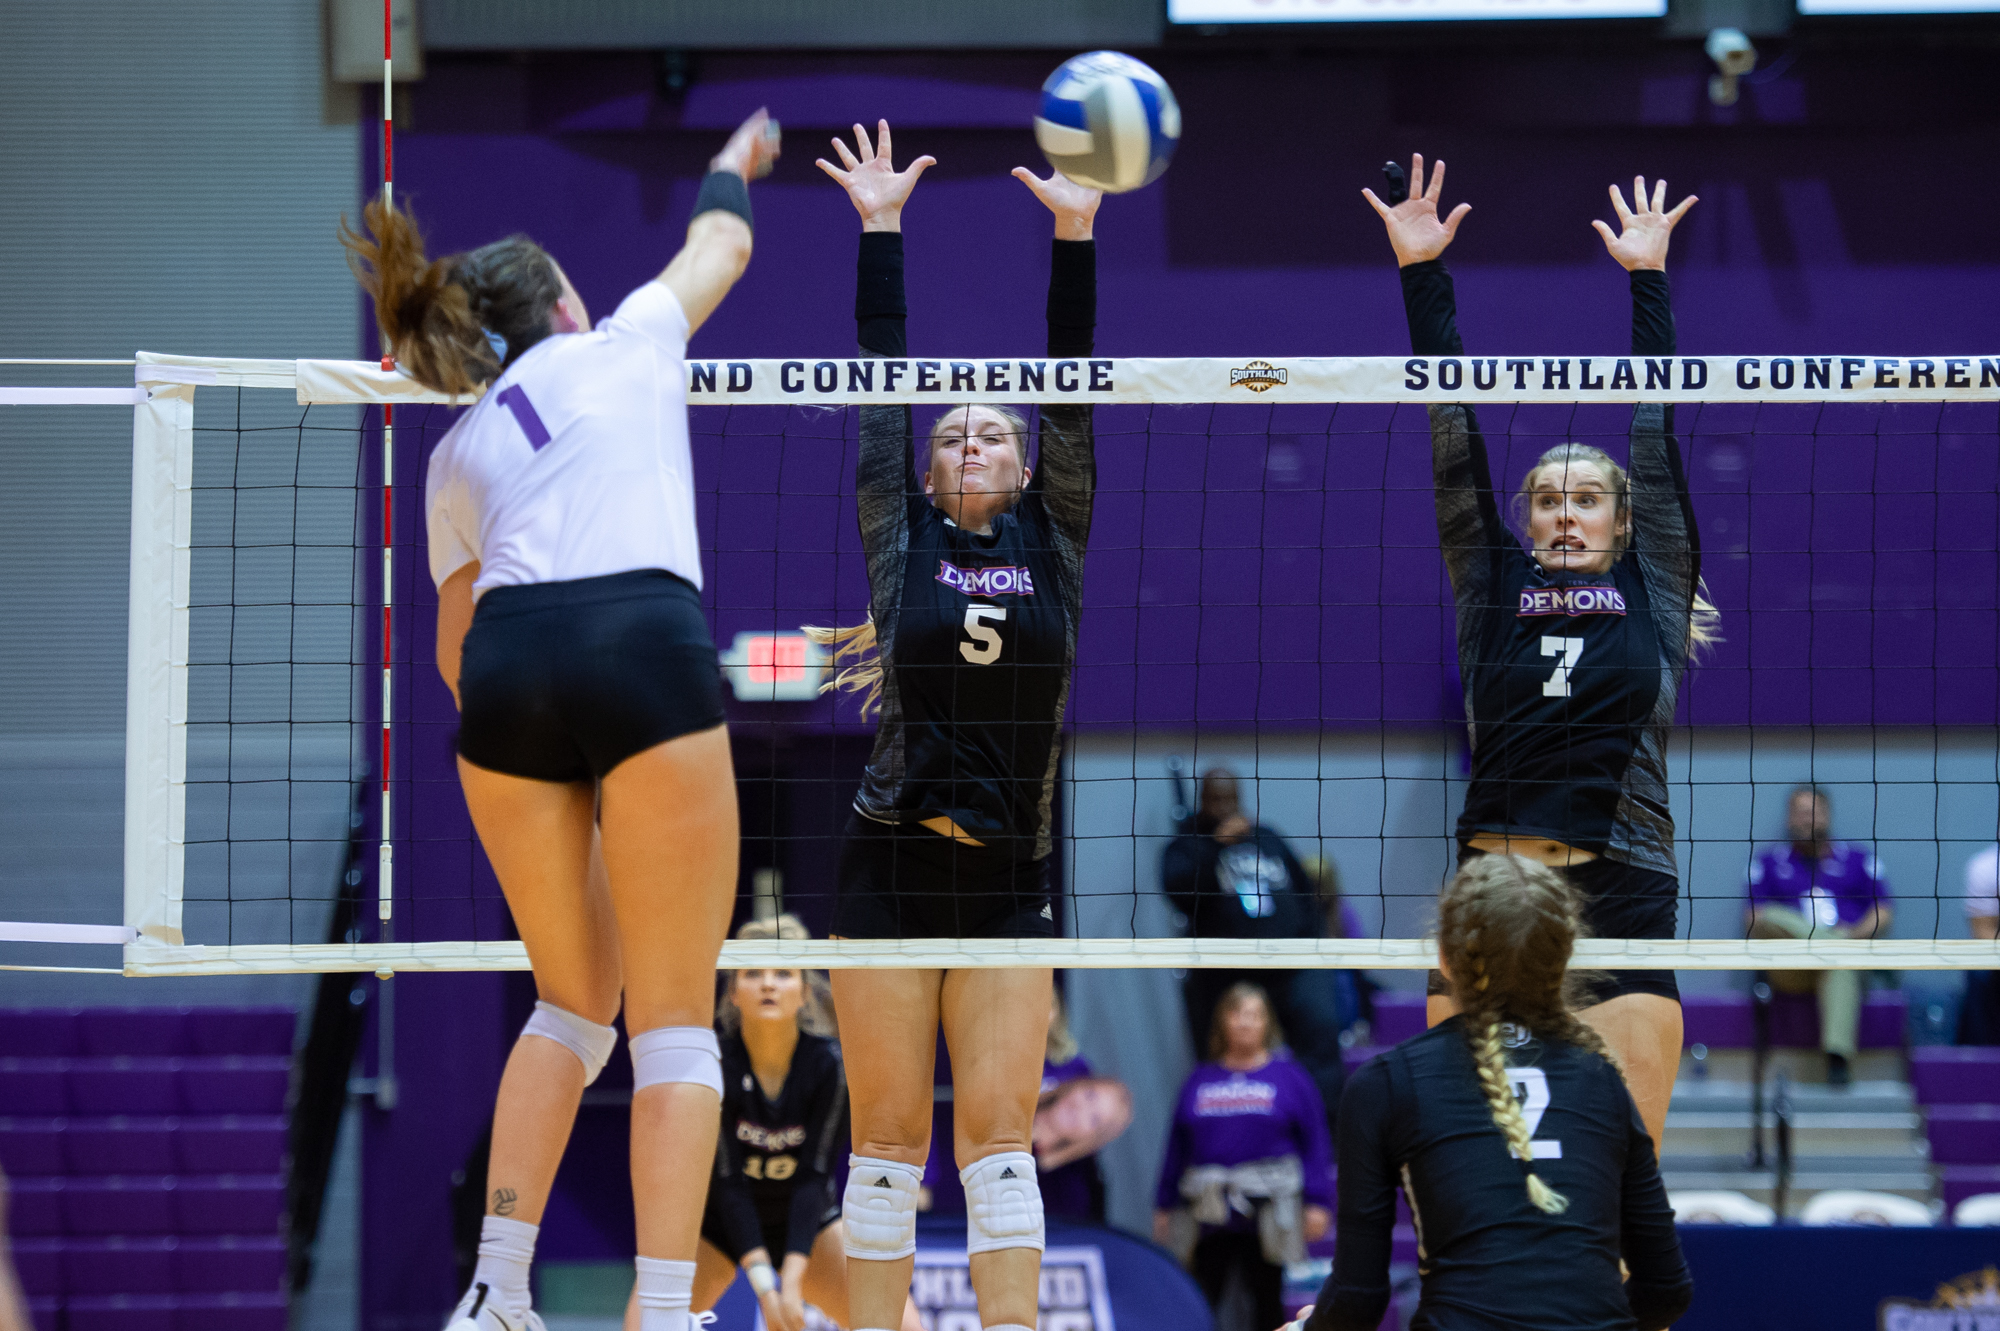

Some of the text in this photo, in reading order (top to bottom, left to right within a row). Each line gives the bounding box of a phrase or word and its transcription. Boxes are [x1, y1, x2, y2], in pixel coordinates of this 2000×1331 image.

[780, 360, 1114, 393] CONFERENCE
[1232, 369, 1286, 384] SOUTHLAND
[1404, 358, 1708, 391] SOUTHLAND
[496, 384, 551, 453] 1
[1520, 590, 1626, 613] DEMONS
[959, 603, 1007, 665] 5
[1540, 635, 1584, 697] 7
[1500, 1068, 1562, 1158] 2
